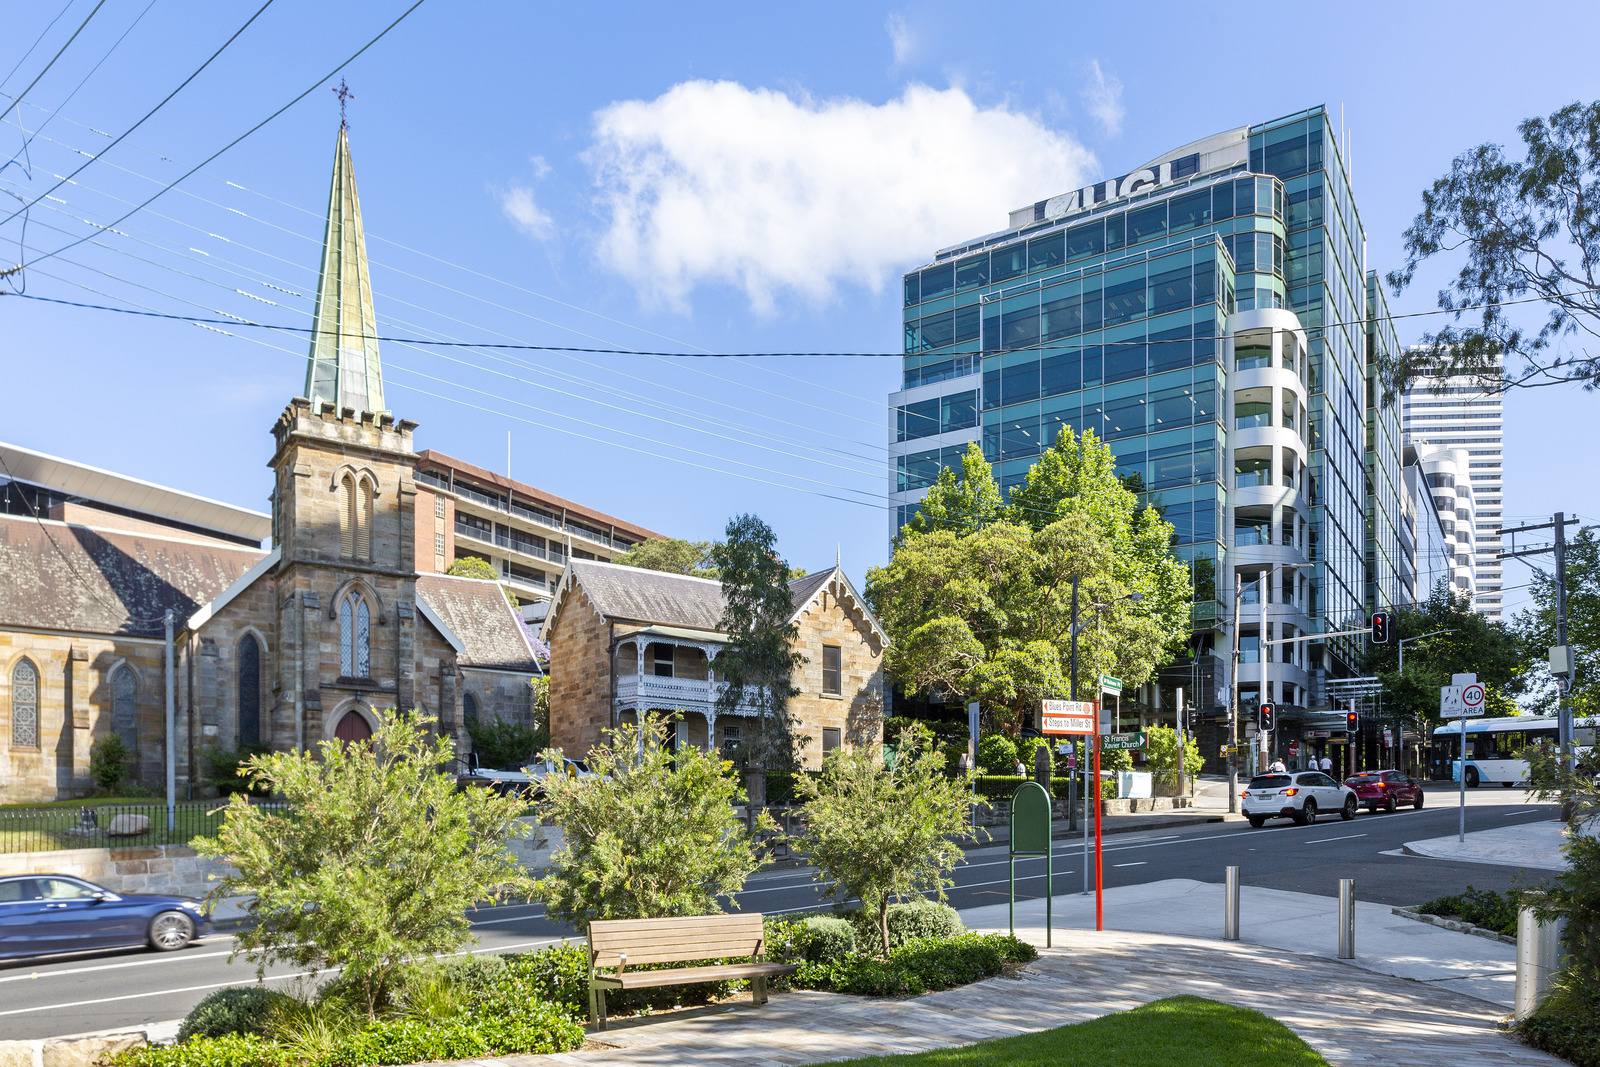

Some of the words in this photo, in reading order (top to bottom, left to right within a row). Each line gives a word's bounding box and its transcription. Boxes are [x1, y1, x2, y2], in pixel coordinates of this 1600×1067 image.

[1466, 691, 1481, 700] 40
[1048, 701, 1062, 710] Blues
[1063, 702, 1075, 711] Point
[1075, 703, 1082, 712] Rd
[1048, 717, 1063, 728] Steps
[1063, 719, 1069, 728] to
[1070, 718, 1083, 728] Miller
[1084, 719, 1091, 729] St
[1104, 735, 1110, 743] St
[1121, 741, 1140, 749] Church
